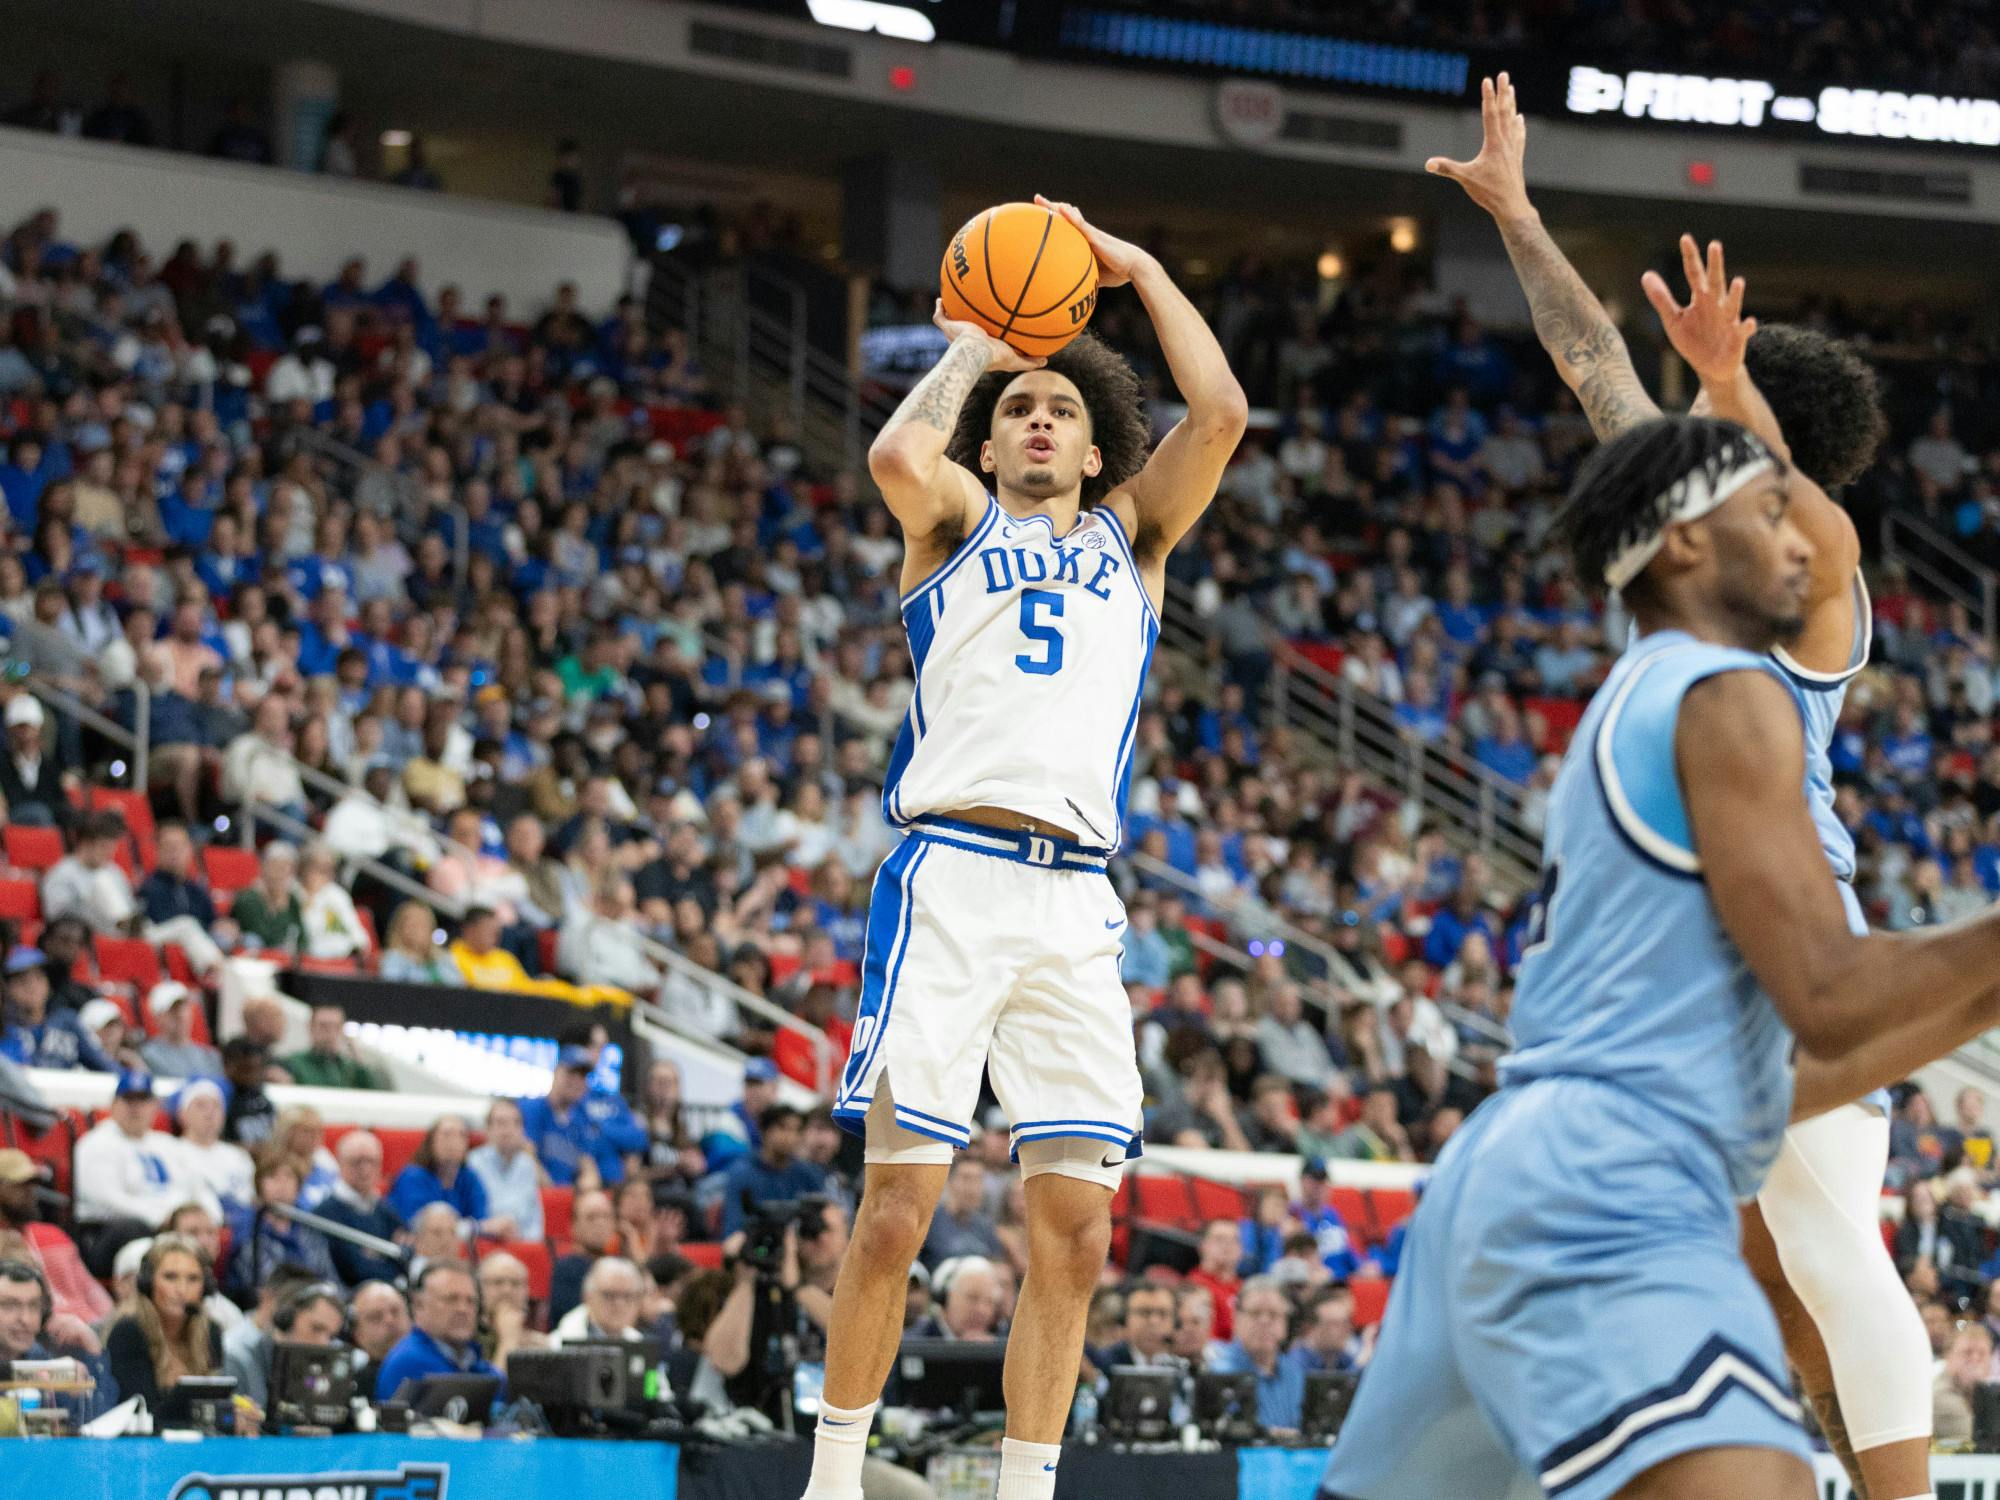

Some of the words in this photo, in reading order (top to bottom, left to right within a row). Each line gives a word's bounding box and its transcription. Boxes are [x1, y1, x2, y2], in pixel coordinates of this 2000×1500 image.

[1623, 71, 1774, 127] FIRST
[979, 547, 1120, 601] DUKE
[1015, 588, 1064, 676] 5
[1026, 836, 1054, 865] D
[854, 1015, 876, 1054] D
